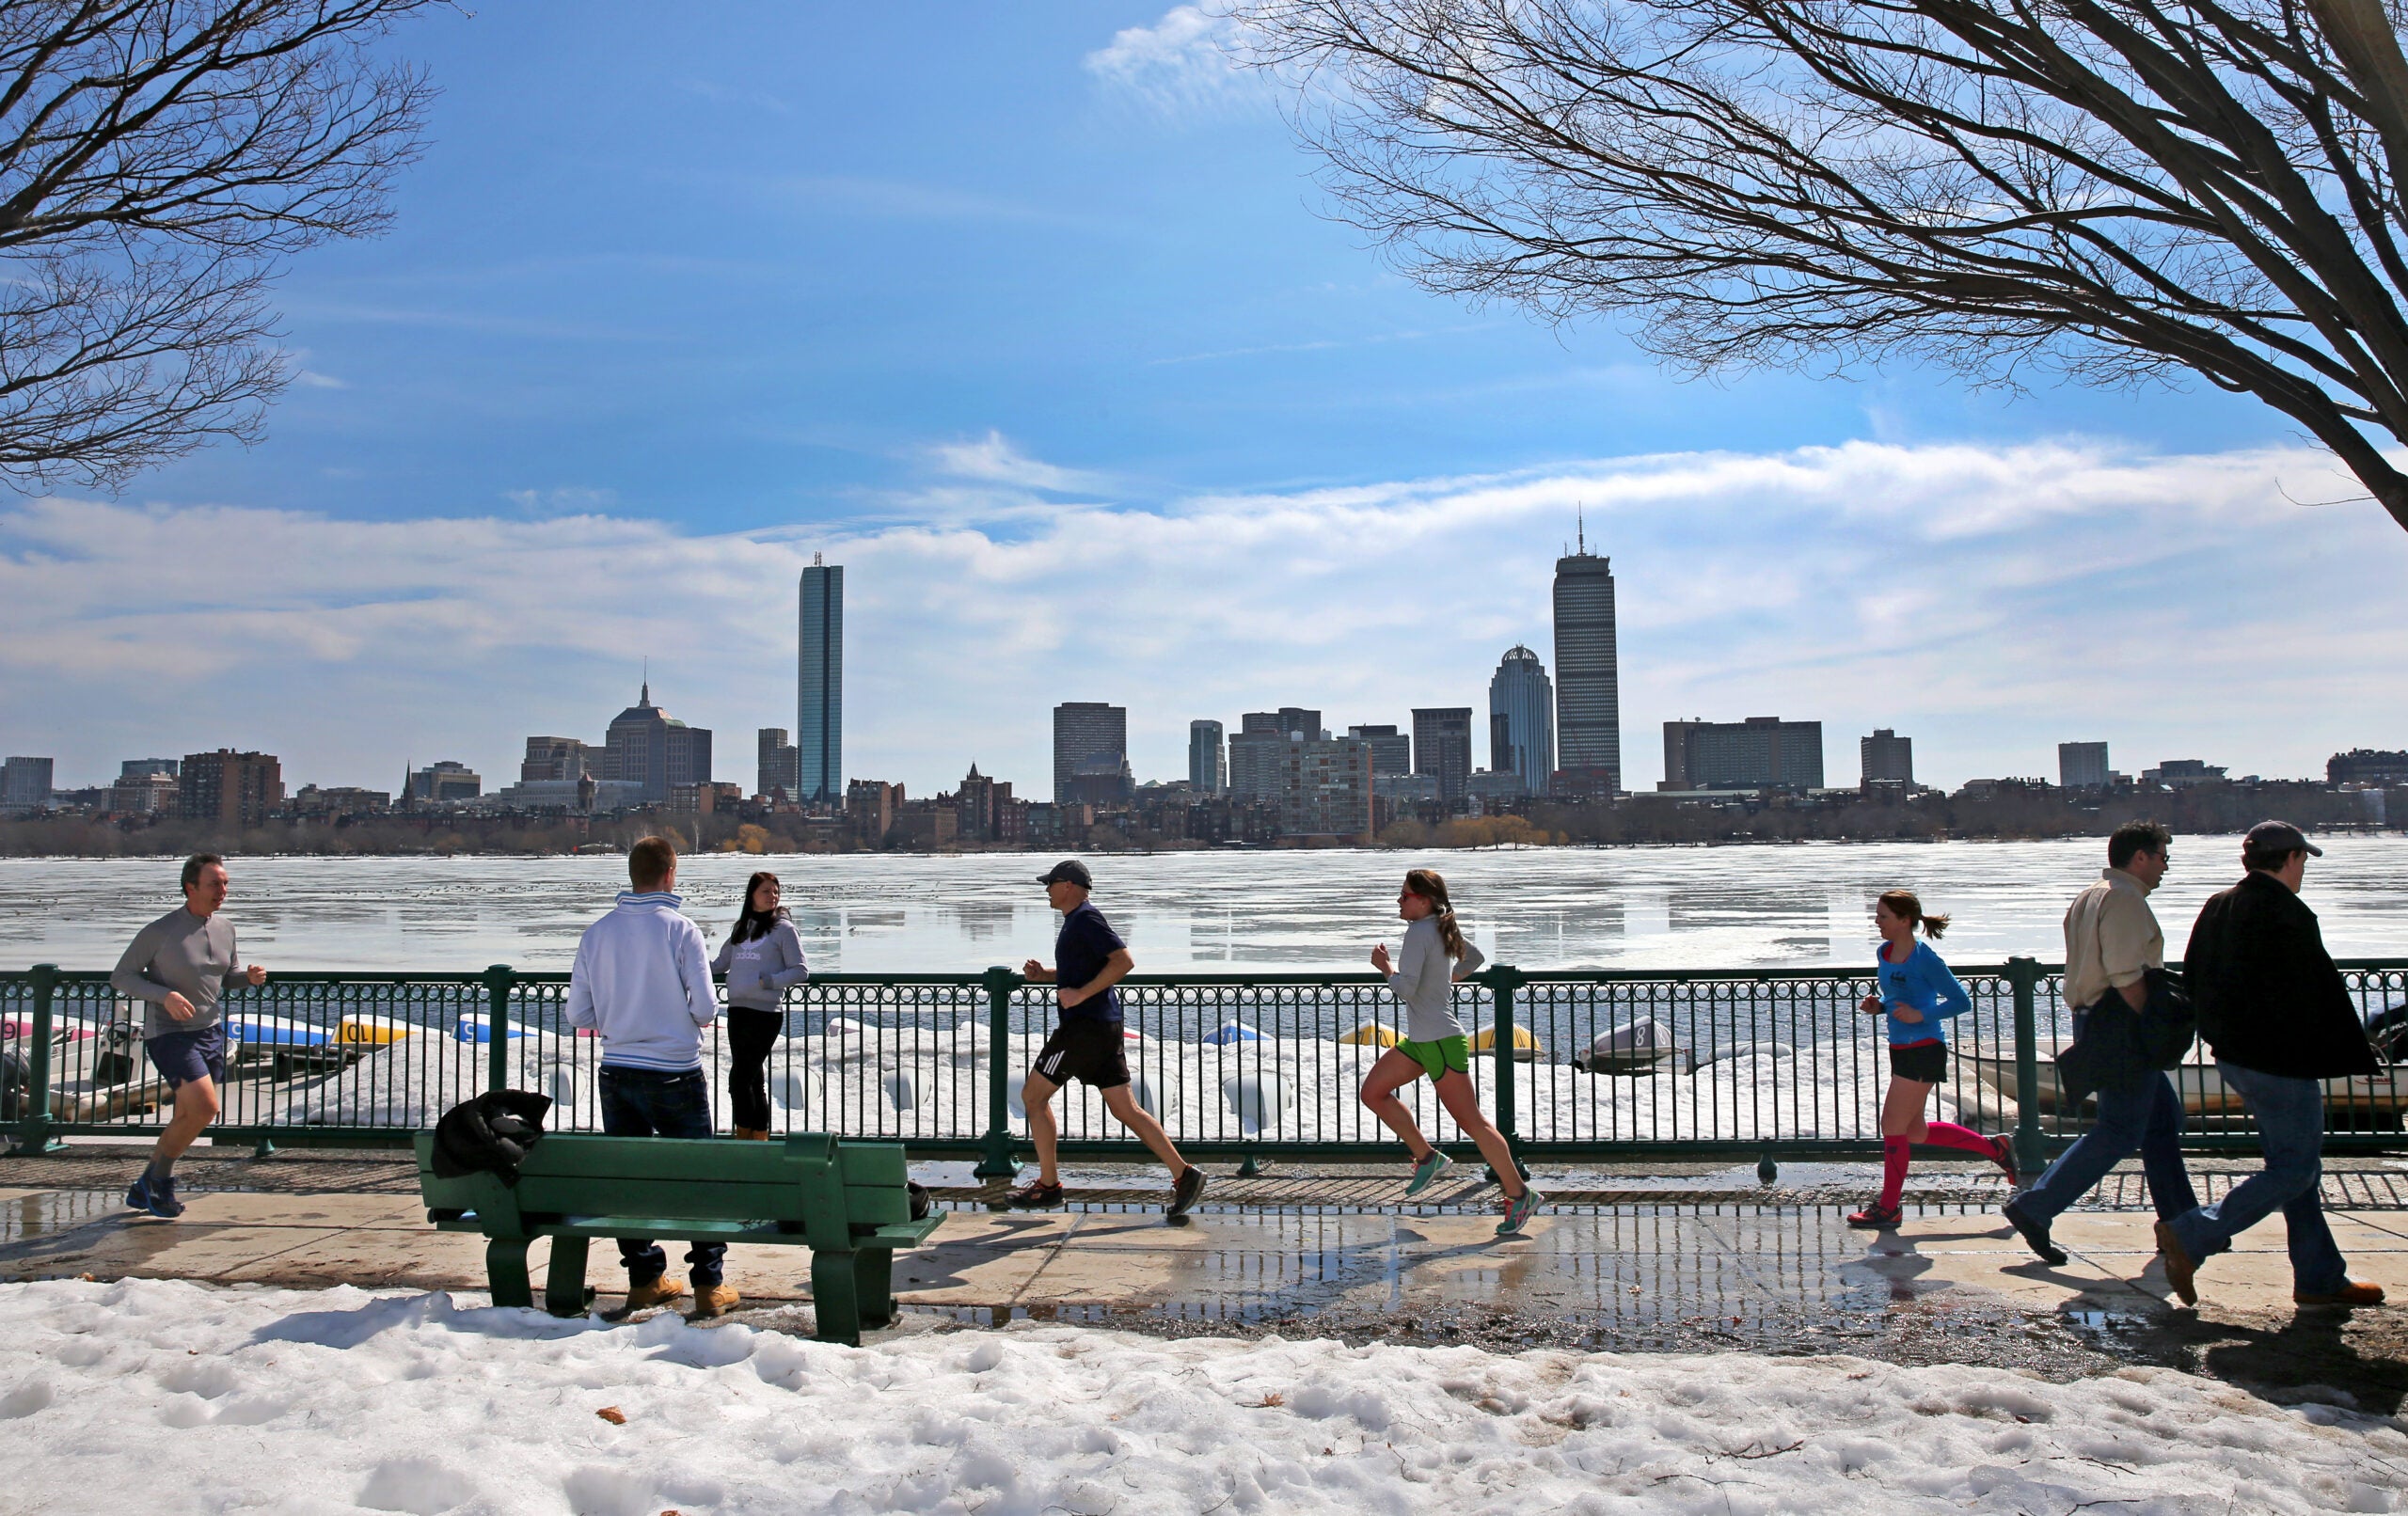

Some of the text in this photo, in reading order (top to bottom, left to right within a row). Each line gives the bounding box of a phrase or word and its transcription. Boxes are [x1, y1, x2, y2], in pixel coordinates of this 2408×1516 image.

[736, 950, 761, 961] adidas
[1636, 1026, 1646, 1047] 8
[1656, 1025, 1666, 1046] 8
